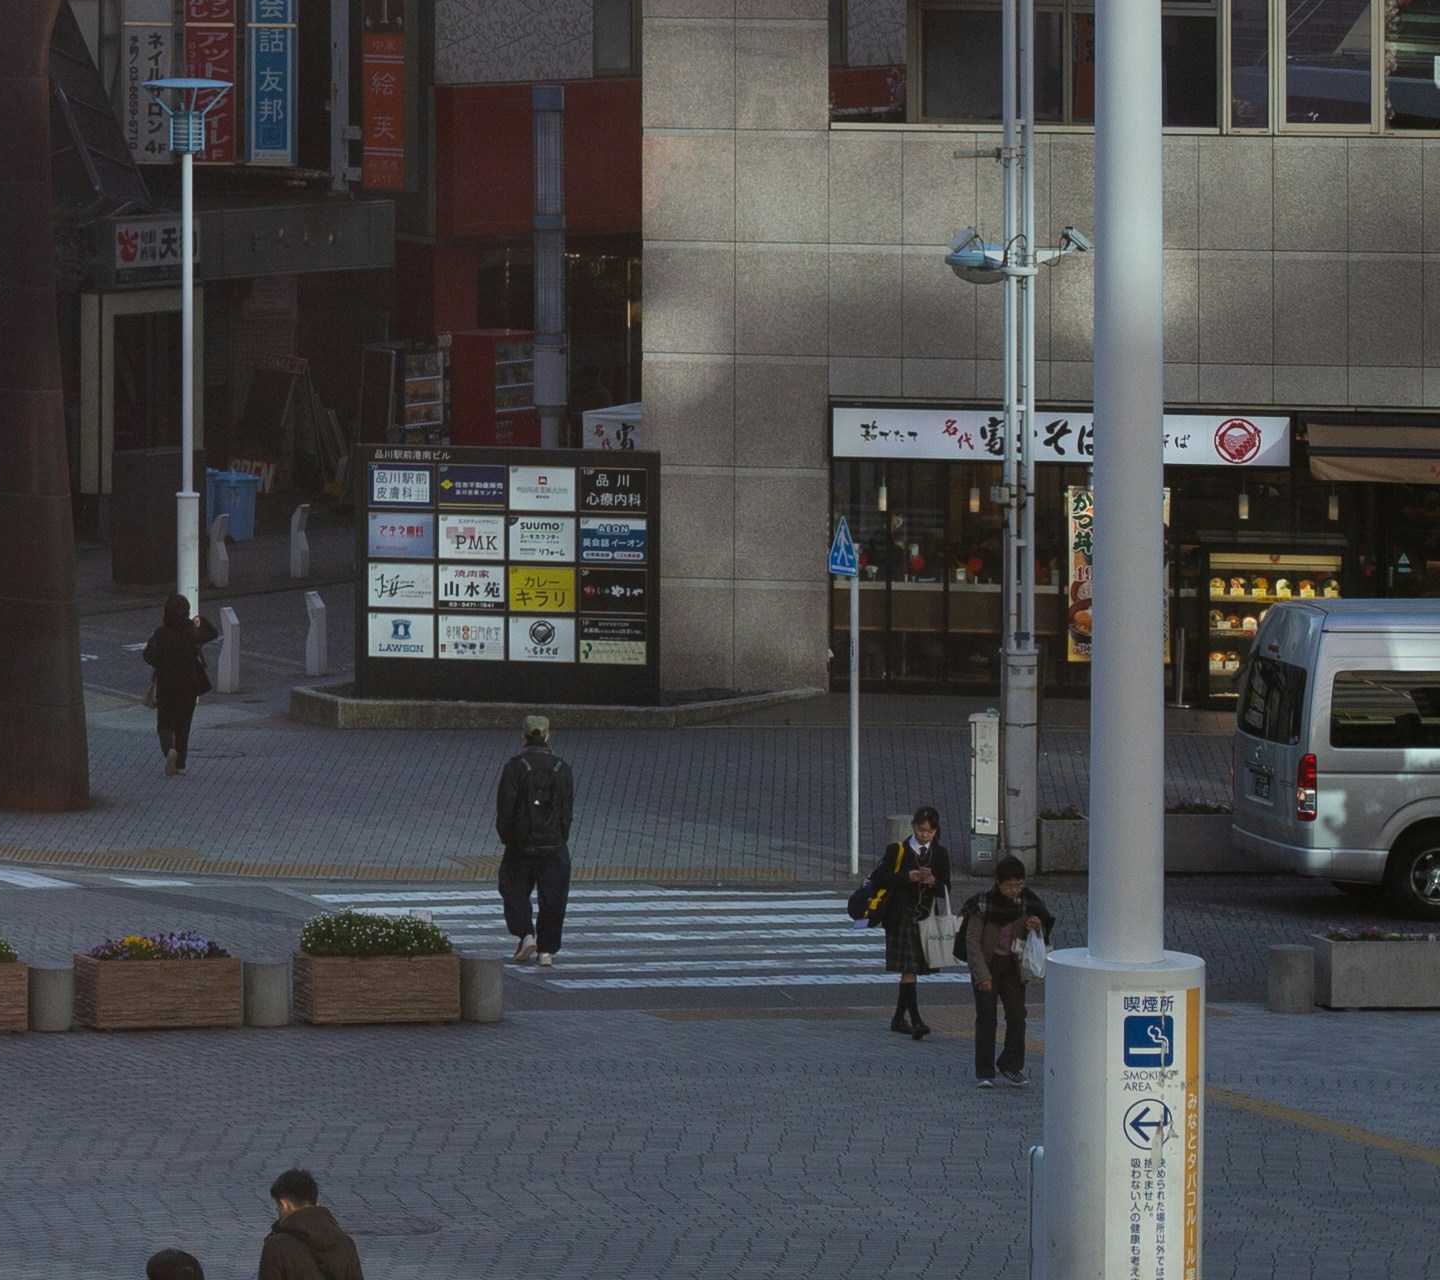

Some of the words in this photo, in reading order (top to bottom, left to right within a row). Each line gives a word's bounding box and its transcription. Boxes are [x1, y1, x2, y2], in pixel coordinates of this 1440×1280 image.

[374, 449, 451, 461] 品川駅前港南ビル
[595, 473, 630, 488] 品川
[585, 492, 642, 507] 心療内科
[597, 523, 630, 535] AEON
[455, 534, 498, 551] PMK
[444, 580, 501, 599] 山水苑
[523, 577, 560, 588] カレー
[515, 590, 567, 608] キラリ
[378, 642, 425, 653] LAWSON
[1123, 994, 1174, 1013] 喫煙所
[1123, 1081, 1153, 1092] AREA
